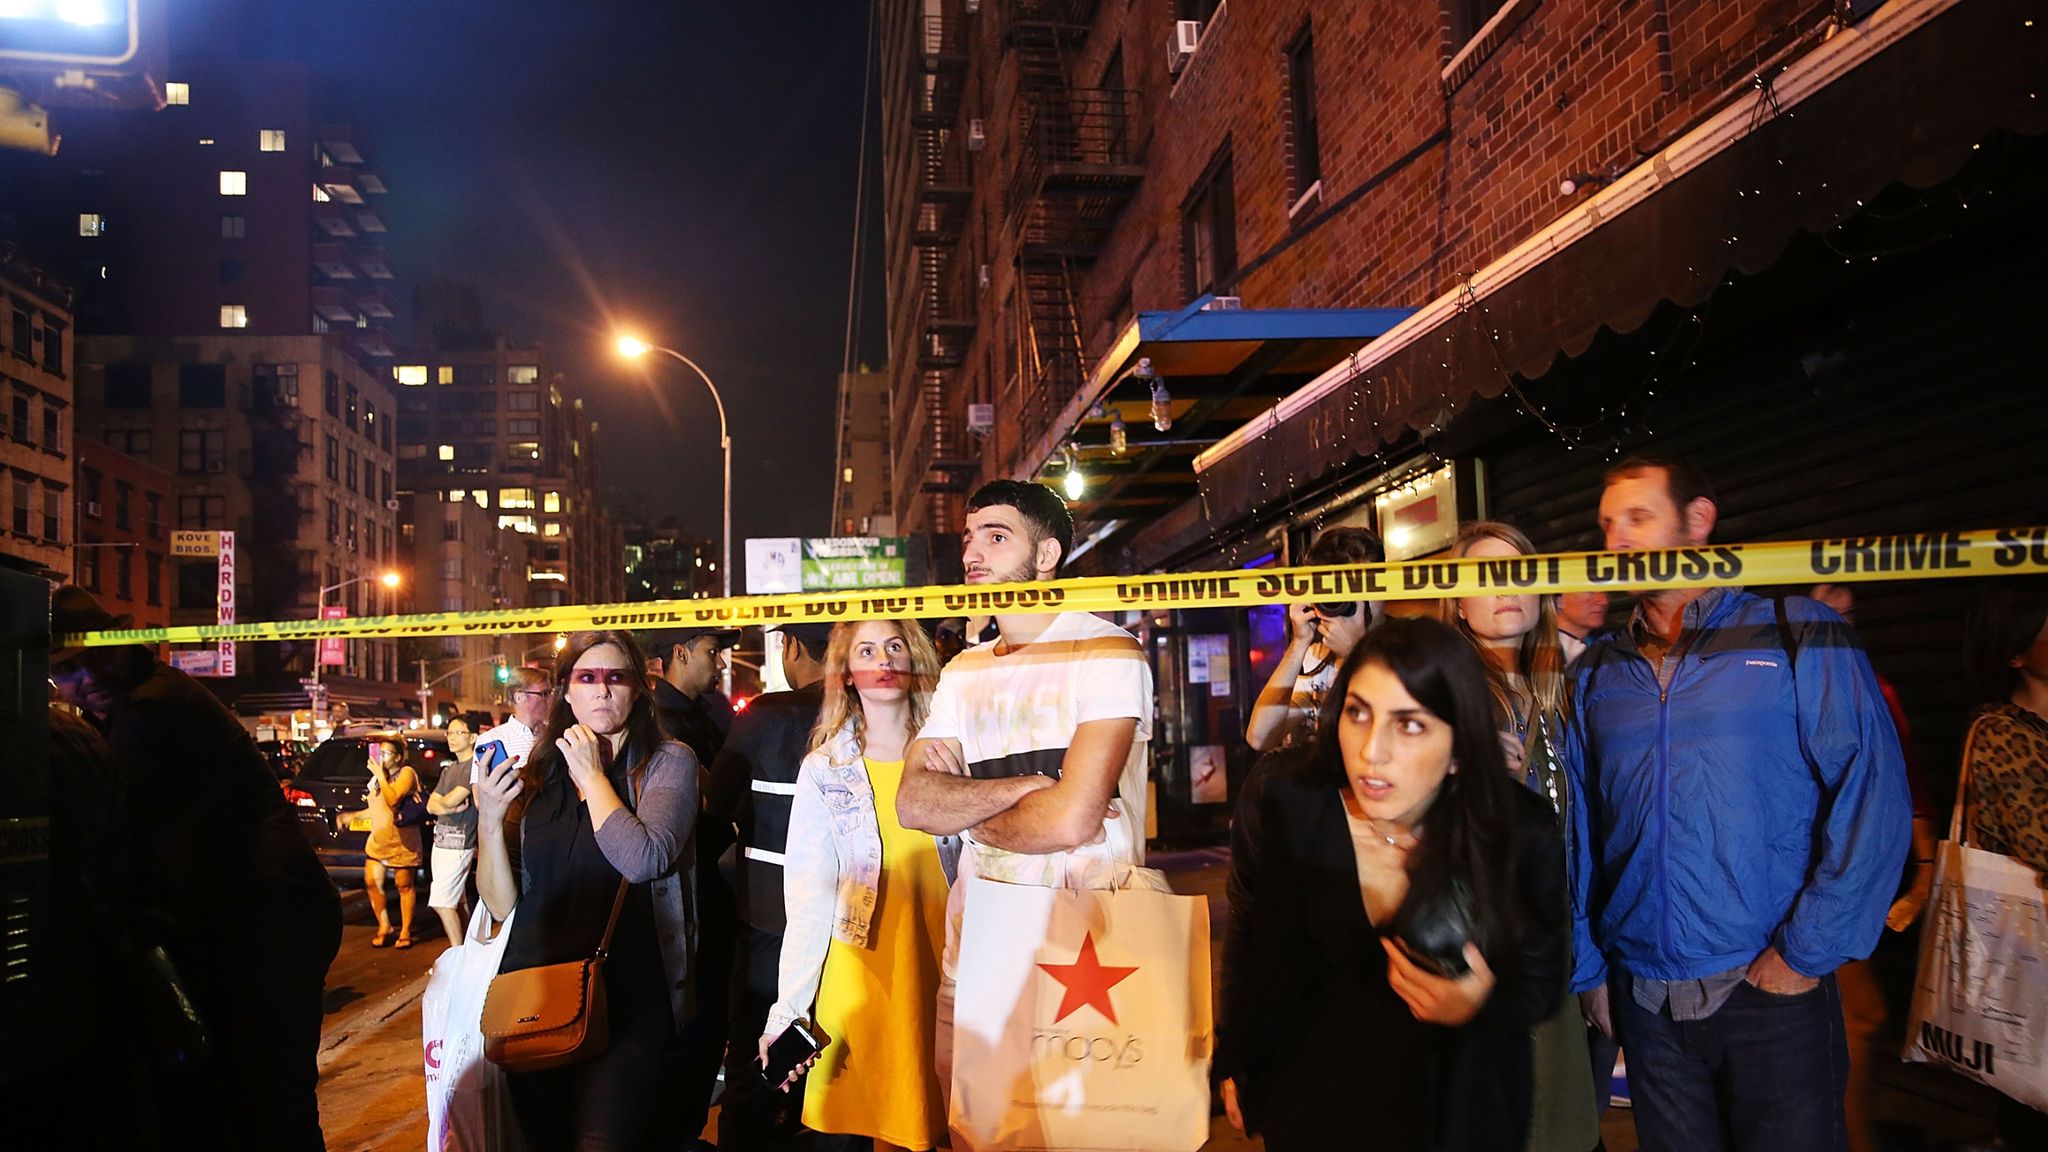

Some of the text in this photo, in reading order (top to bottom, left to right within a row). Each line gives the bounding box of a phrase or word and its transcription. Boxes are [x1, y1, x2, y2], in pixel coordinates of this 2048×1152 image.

[175, 545, 215, 554] BROS.
[176, 533, 212, 542] KOVE
[1811, 532, 1972, 576] CRIME
[1256, 567, 1387, 597] SCENE
[1402, 563, 1459, 591] DO
[1478, 557, 1559, 588] NOT
[1586, 547, 1743, 583] CROSS
[220, 535, 234, 674] HARDWRE
[1921, 1020, 1996, 1076] MUJI
